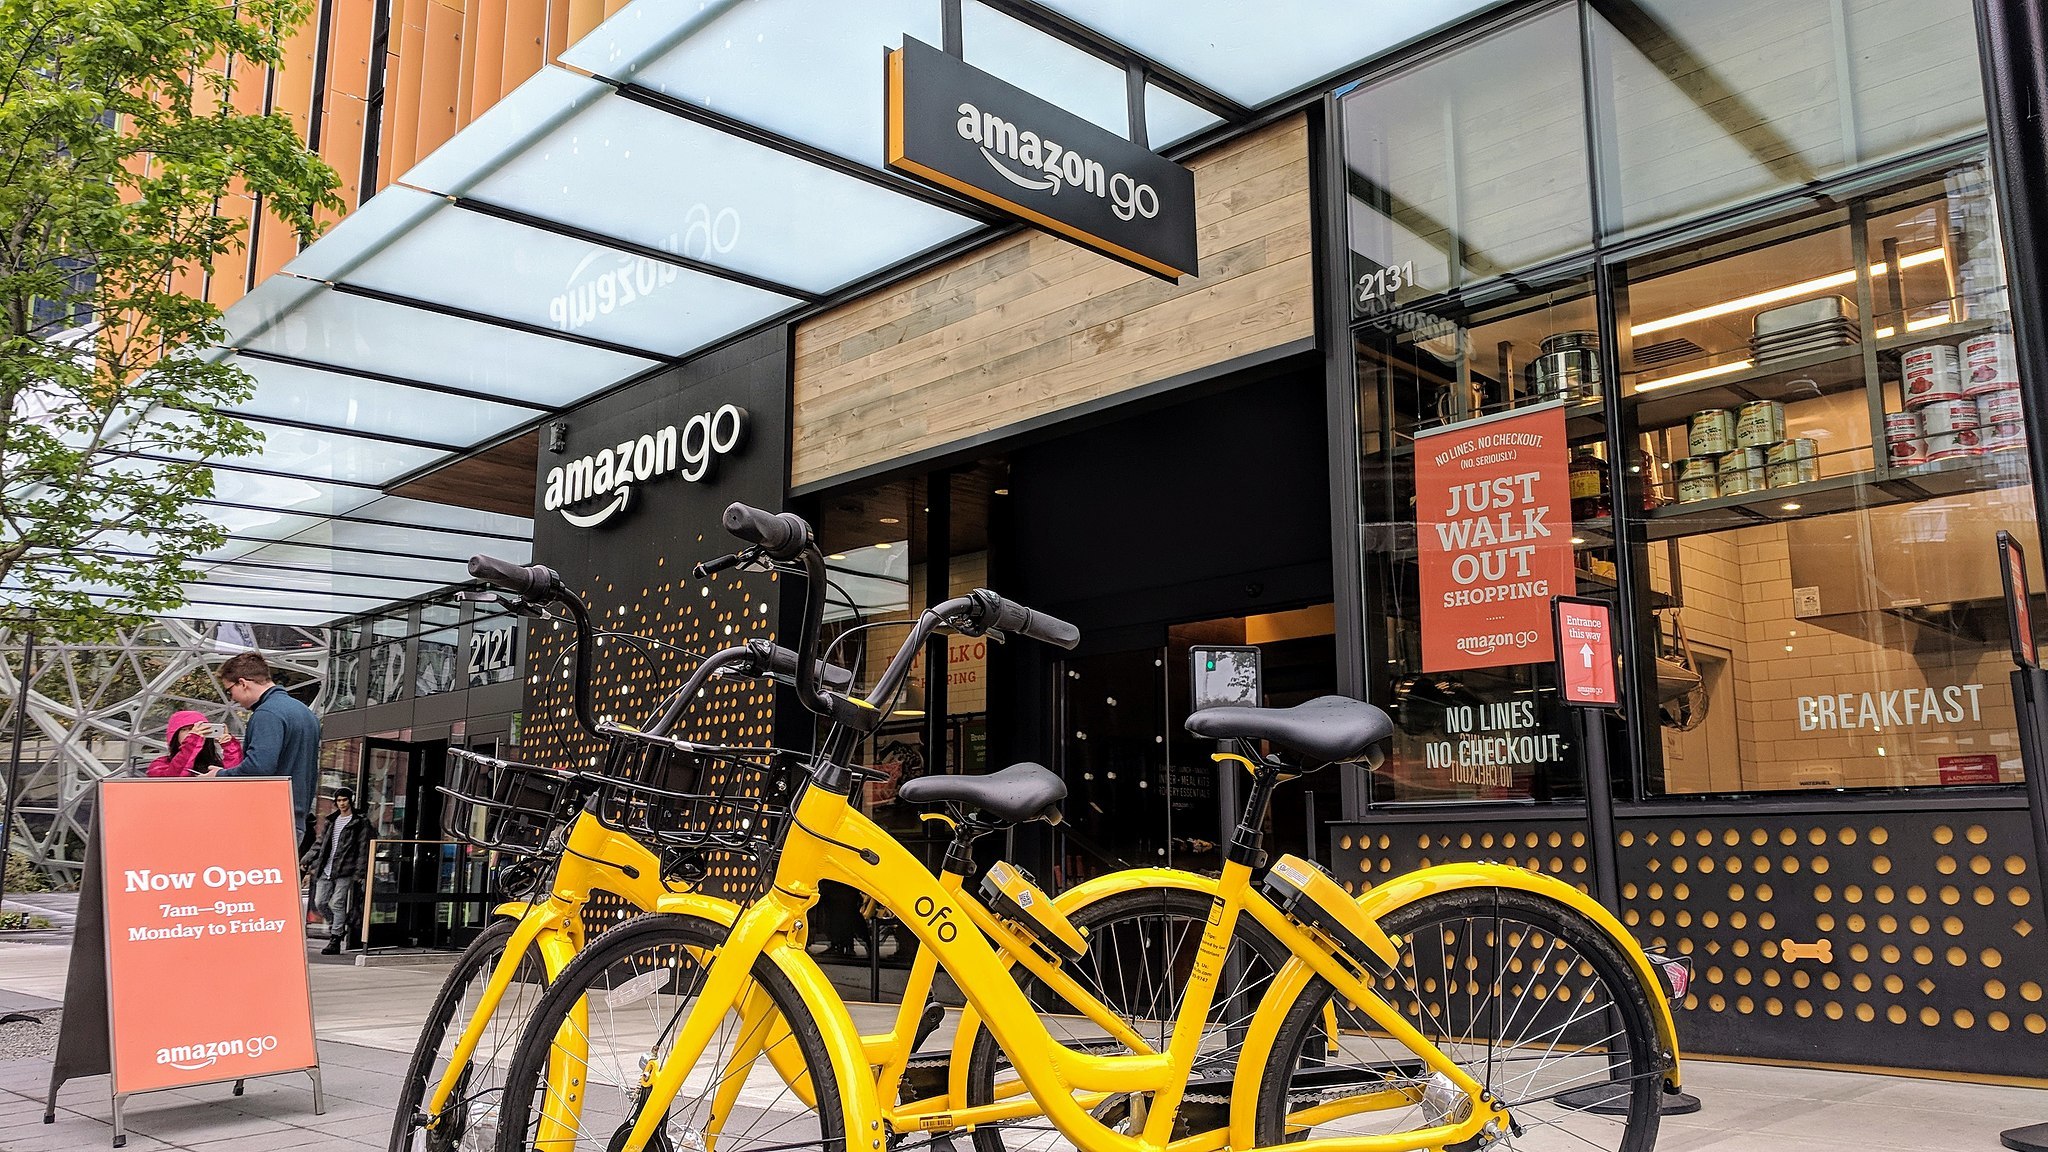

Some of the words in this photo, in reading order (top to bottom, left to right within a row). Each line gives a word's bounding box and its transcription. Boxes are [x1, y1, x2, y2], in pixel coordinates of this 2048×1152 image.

[957, 102, 1105, 198] amazon
[1109, 172, 1159, 221] go
[1359, 260, 1414, 302] 2131
[544, 425, 677, 512] amazon
[681, 403, 742, 482] go
[1435, 453, 1449, 467] NO
[1449, 440, 1477, 460] LINES.
[1478, 435, 1491, 449] NO
[1493, 433, 1544, 448] CHECKOUT.
[1460, 459, 1475, 470] (NO.
[1475, 449, 1517, 466] SERIOUSLY.)
[1446, 471, 1540, 517] JUST
[1435, 505, 1551, 552] WALK
[1451, 544, 1536, 585] OUT
[1443, 579, 1549, 608] SHOPPING
[1566, 615, 1602, 628] Entrance
[1569, 628, 1585, 639] this
[1585, 632, 1601, 642] way
[468, 625, 517, 674] 2121
[1456, 632, 1514, 651] amazon
[1515, 630, 1538, 649] go
[1577, 686, 1595, 694] amazon
[1446, 705, 1473, 734] NO
[1479, 700, 1540, 731] LINES.
[1797, 683, 1984, 732] BREAKFAST
[1425, 741, 1452, 769] NO
[1458, 733, 1564, 767] CHECKOUT.
[124, 869, 197, 892] Now
[202, 866, 283, 891] Open
[128, 923, 205, 942] Monday
[207, 922, 226, 935] to
[229, 918, 286, 933] Friday
[914, 896, 957, 943] ofo
[156, 1037, 244, 1064] amazon
[246, 1035, 278, 1058] go
